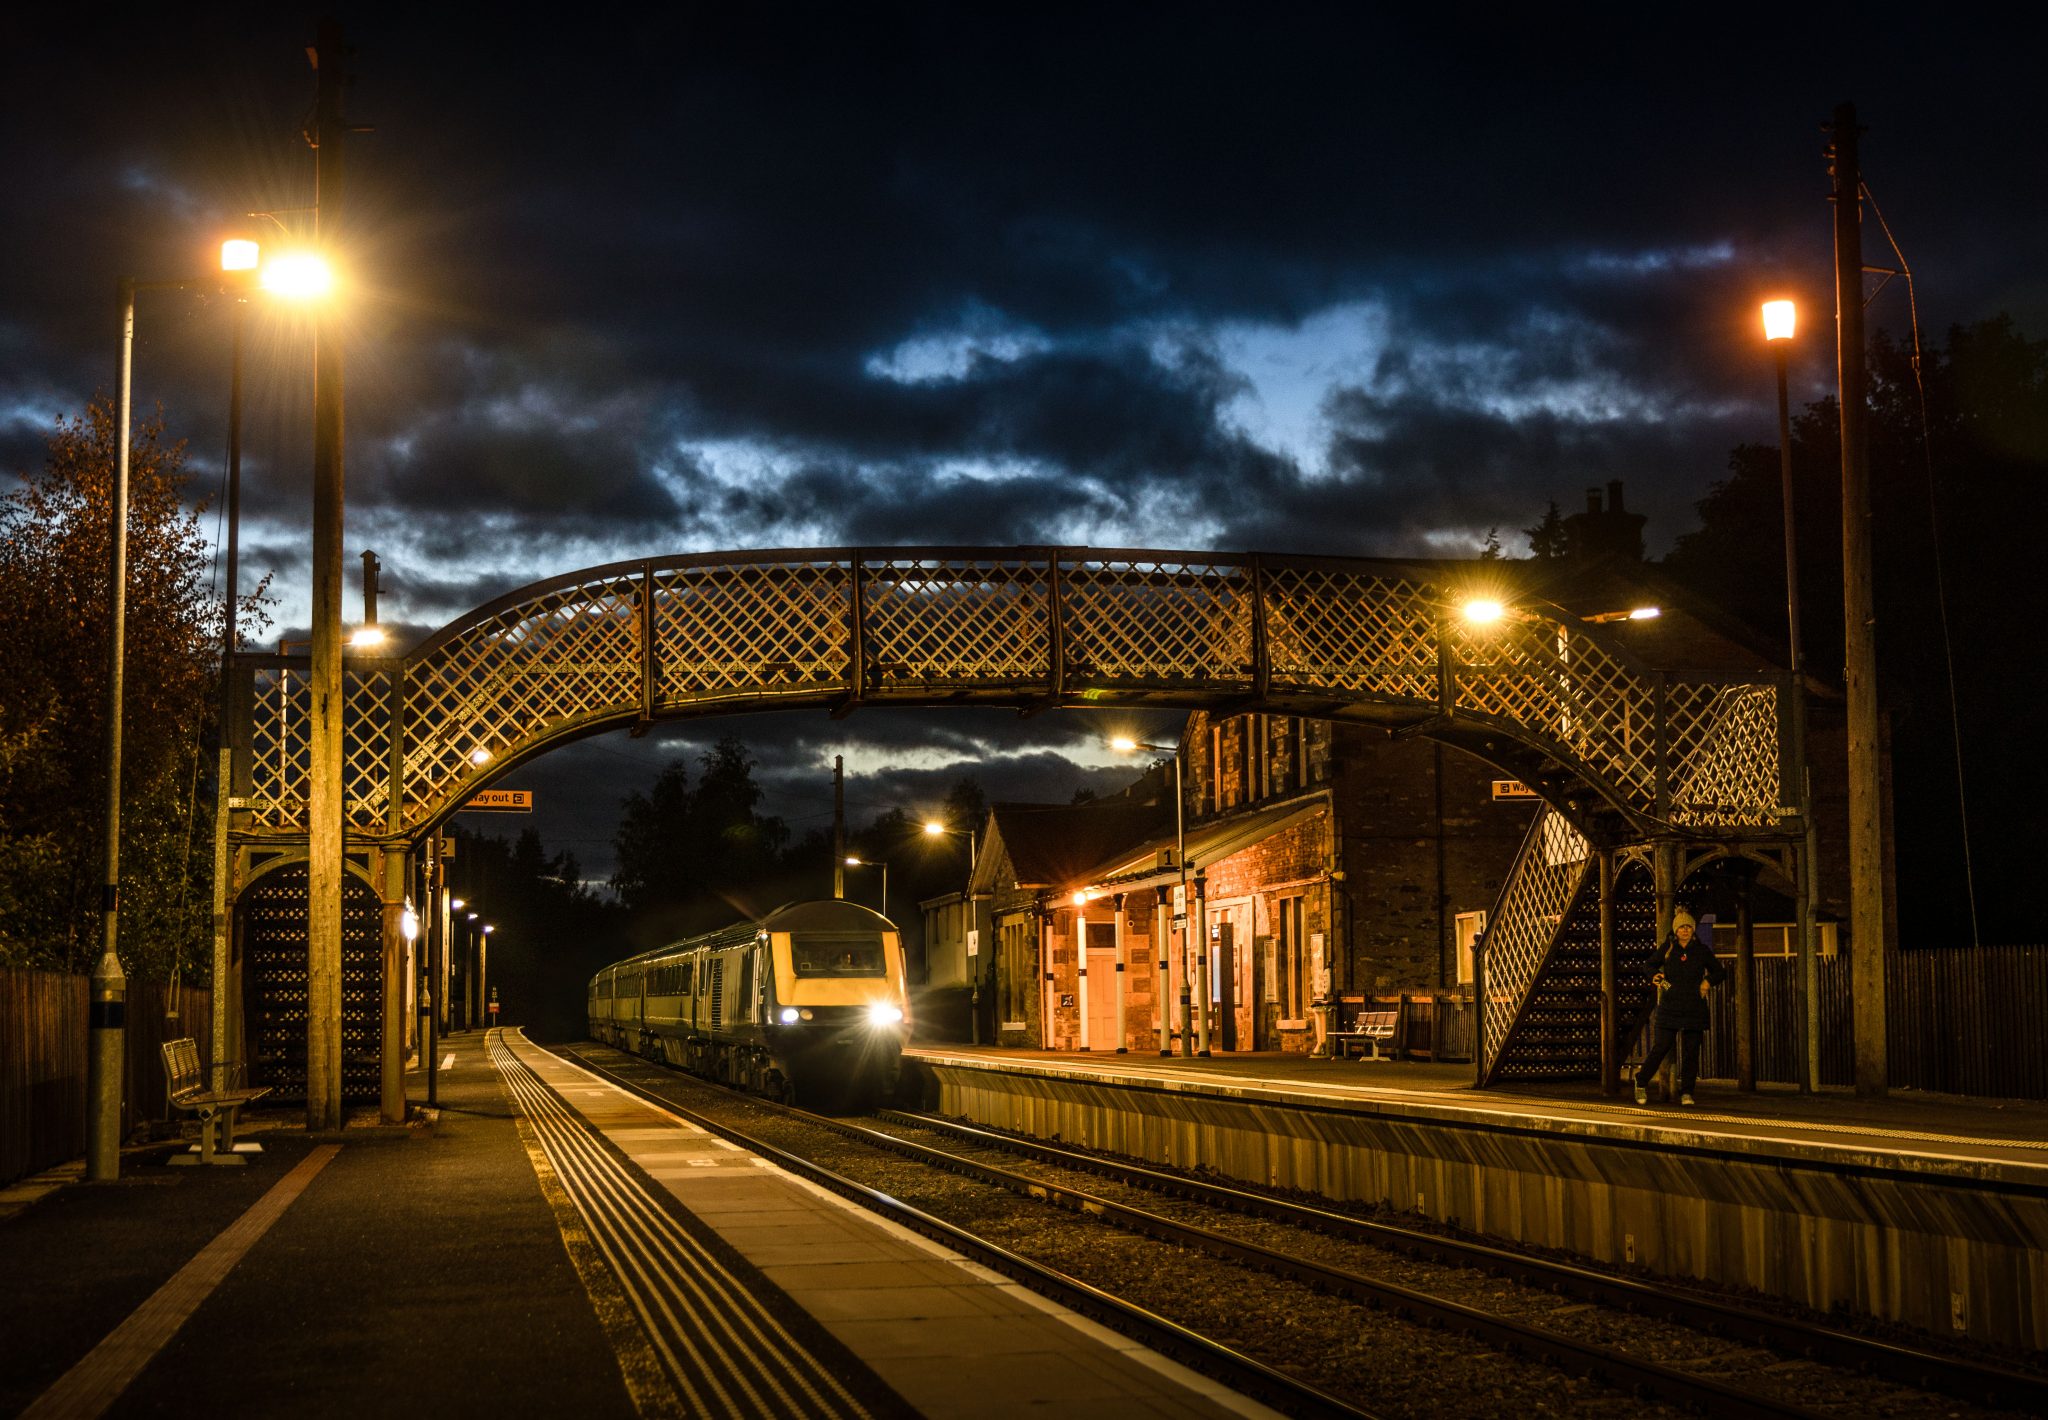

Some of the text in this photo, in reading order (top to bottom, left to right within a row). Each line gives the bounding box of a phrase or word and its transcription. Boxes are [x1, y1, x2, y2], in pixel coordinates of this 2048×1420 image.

[492, 793, 509, 802] out
[440, 839, 447, 855] 2
[1163, 849, 1173, 865] 1
